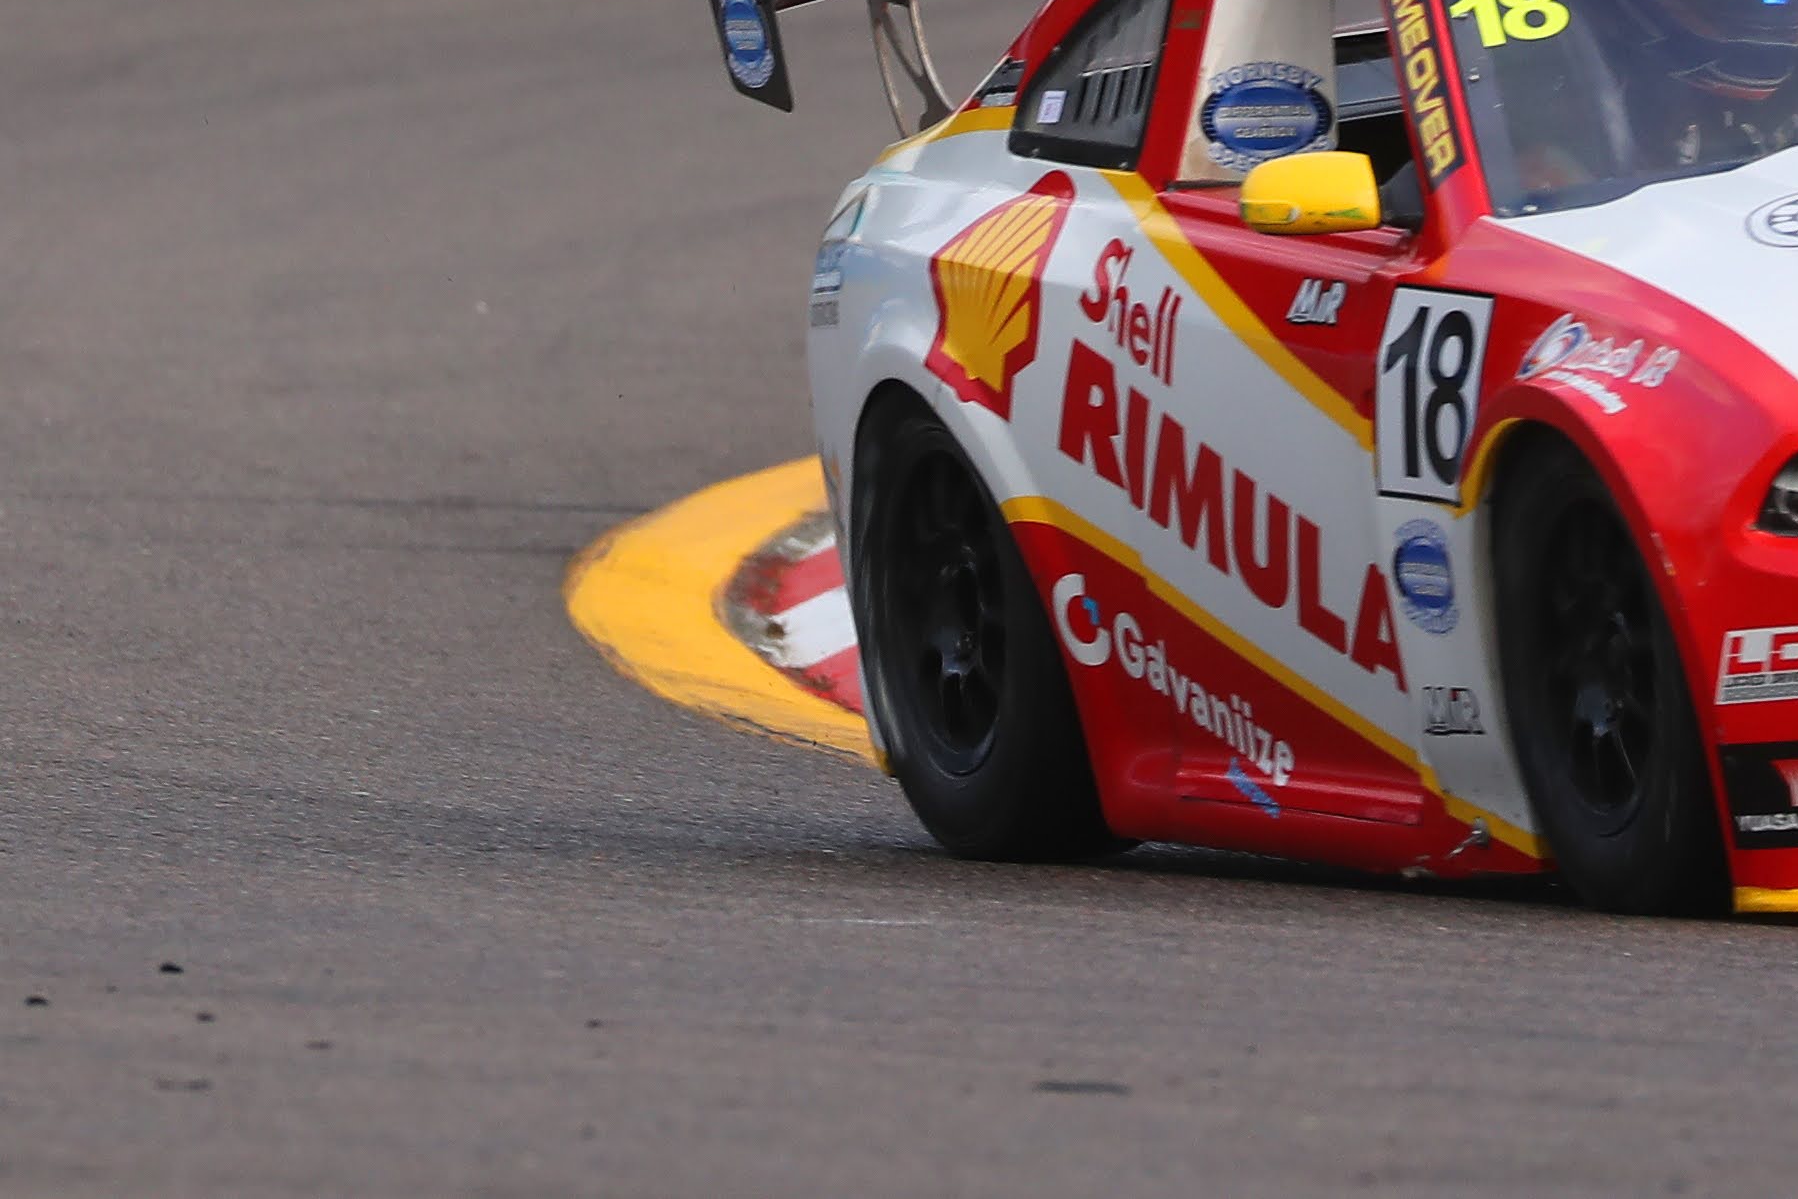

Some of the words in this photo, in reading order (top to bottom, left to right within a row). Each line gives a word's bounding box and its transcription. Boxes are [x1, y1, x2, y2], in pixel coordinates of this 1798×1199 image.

[1080, 238, 1184, 387] Shell
[1384, 305, 1476, 486] 18
[1057, 336, 1408, 693] RIMULA
